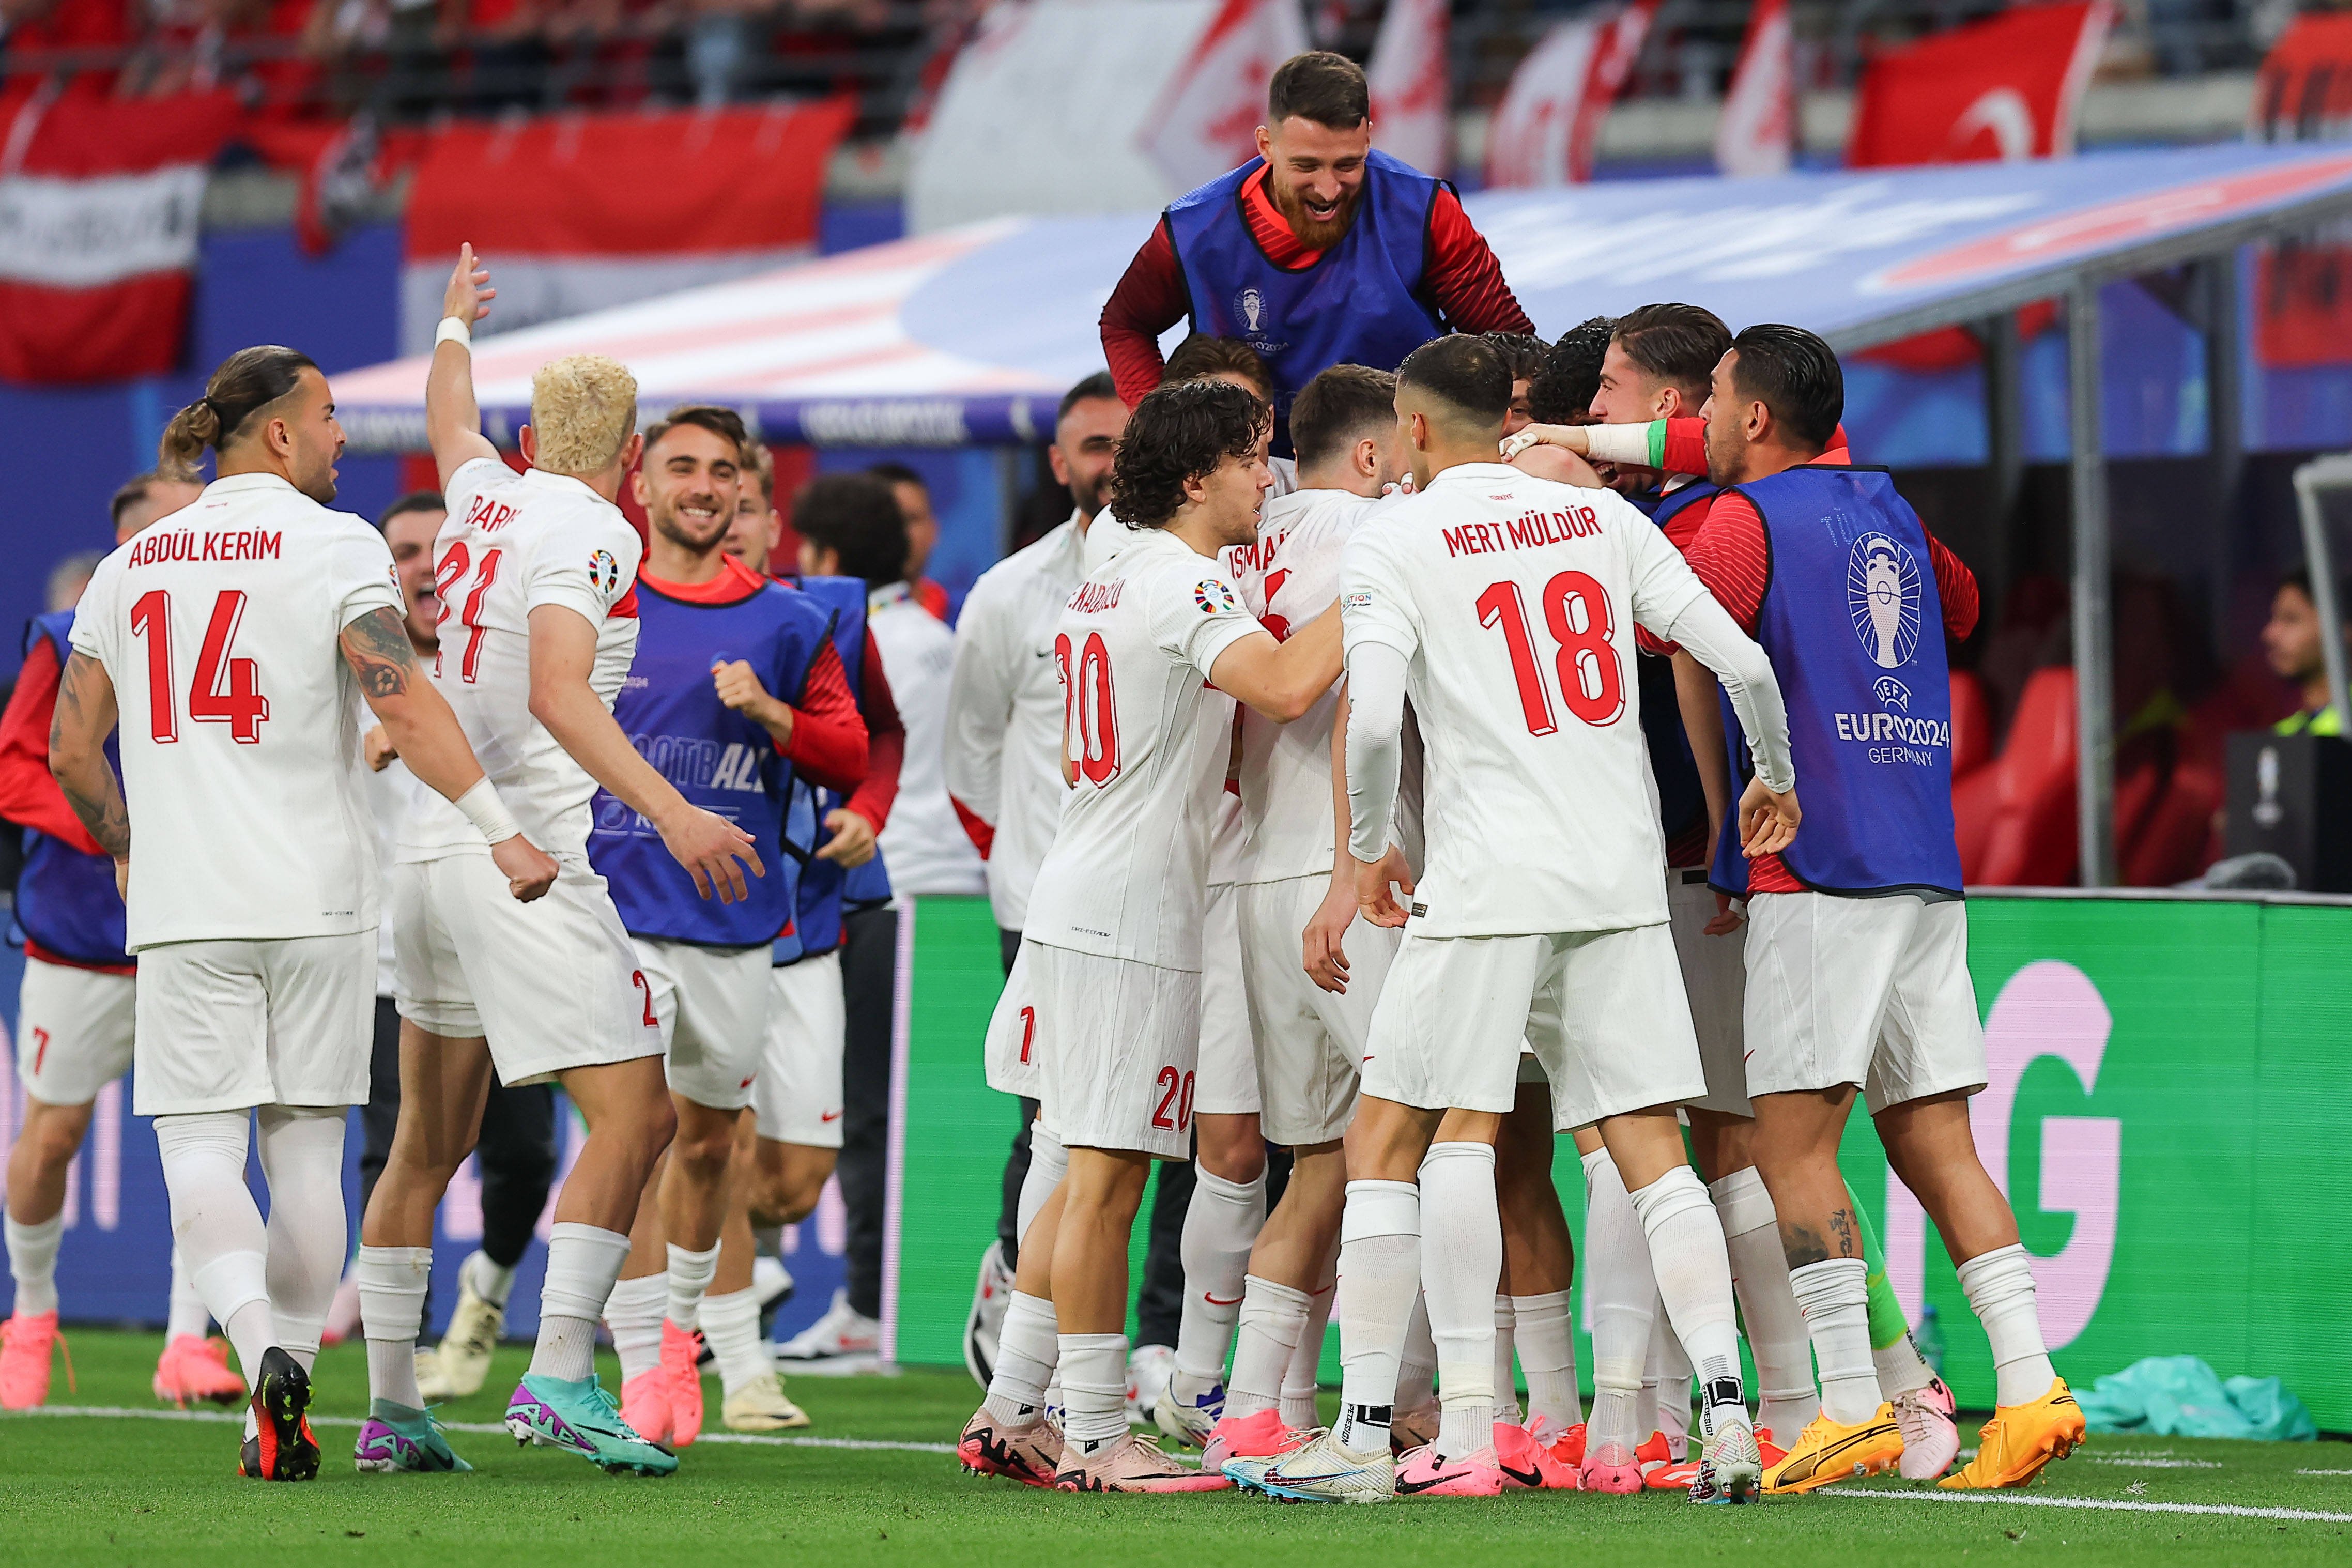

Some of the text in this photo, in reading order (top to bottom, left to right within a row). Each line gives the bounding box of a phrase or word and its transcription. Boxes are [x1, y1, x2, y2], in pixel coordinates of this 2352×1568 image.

[128, 526, 282, 569] ABDÜLKERİM
[1442, 505, 1603, 558] MERT MÜLDÜR
[131, 590, 270, 744] 14
[1475, 571, 1626, 737] 18
[1876, 682, 1909, 709] UEFA
[1868, 747, 1932, 766] GERMANY
[34, 1026, 49, 1075] 7
[1152, 1066, 1195, 1133] 20
